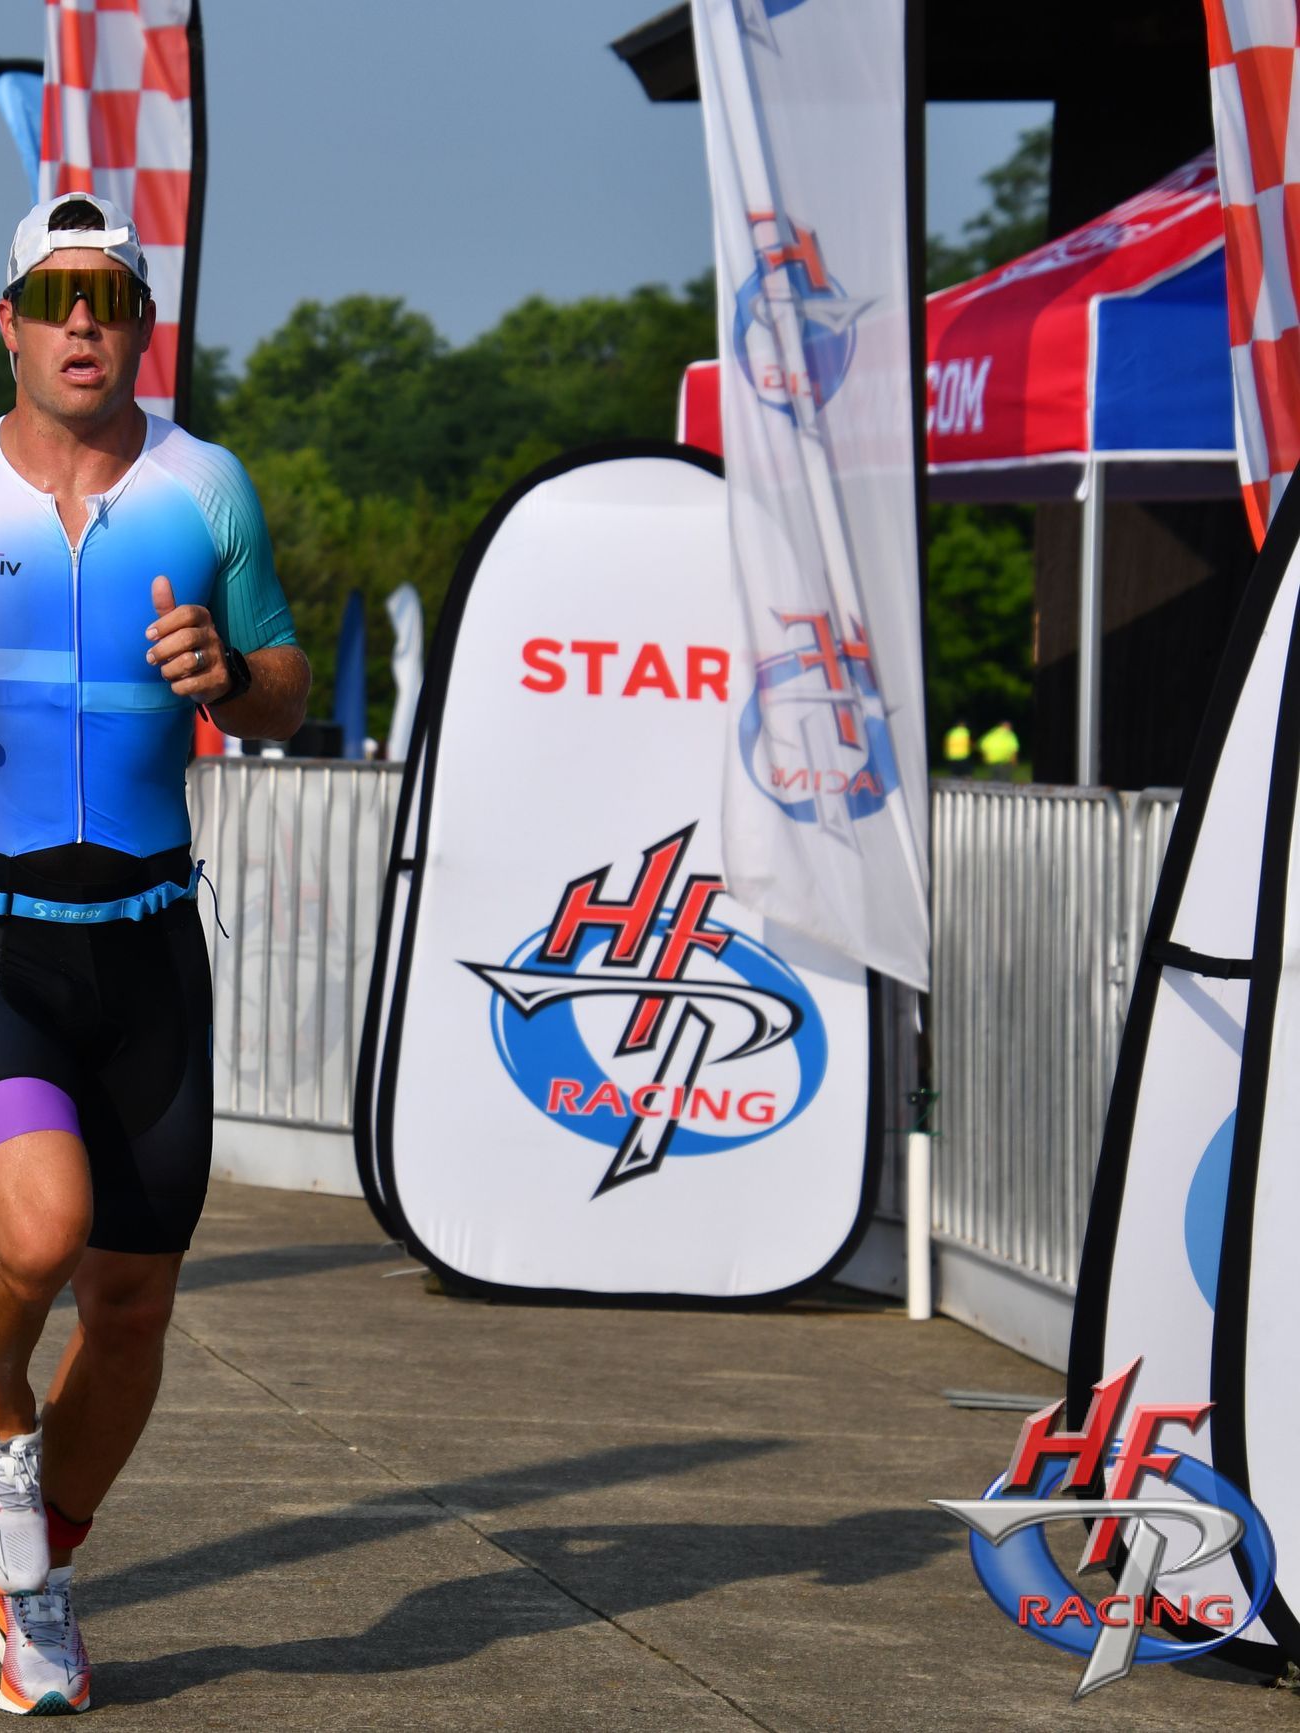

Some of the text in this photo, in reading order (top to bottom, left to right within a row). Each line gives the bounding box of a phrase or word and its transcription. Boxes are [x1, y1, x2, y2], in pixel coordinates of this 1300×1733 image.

[520, 637, 731, 703] STAR
[50, 907, 101, 920] synergy
[546, 1078, 777, 1124] RACING
